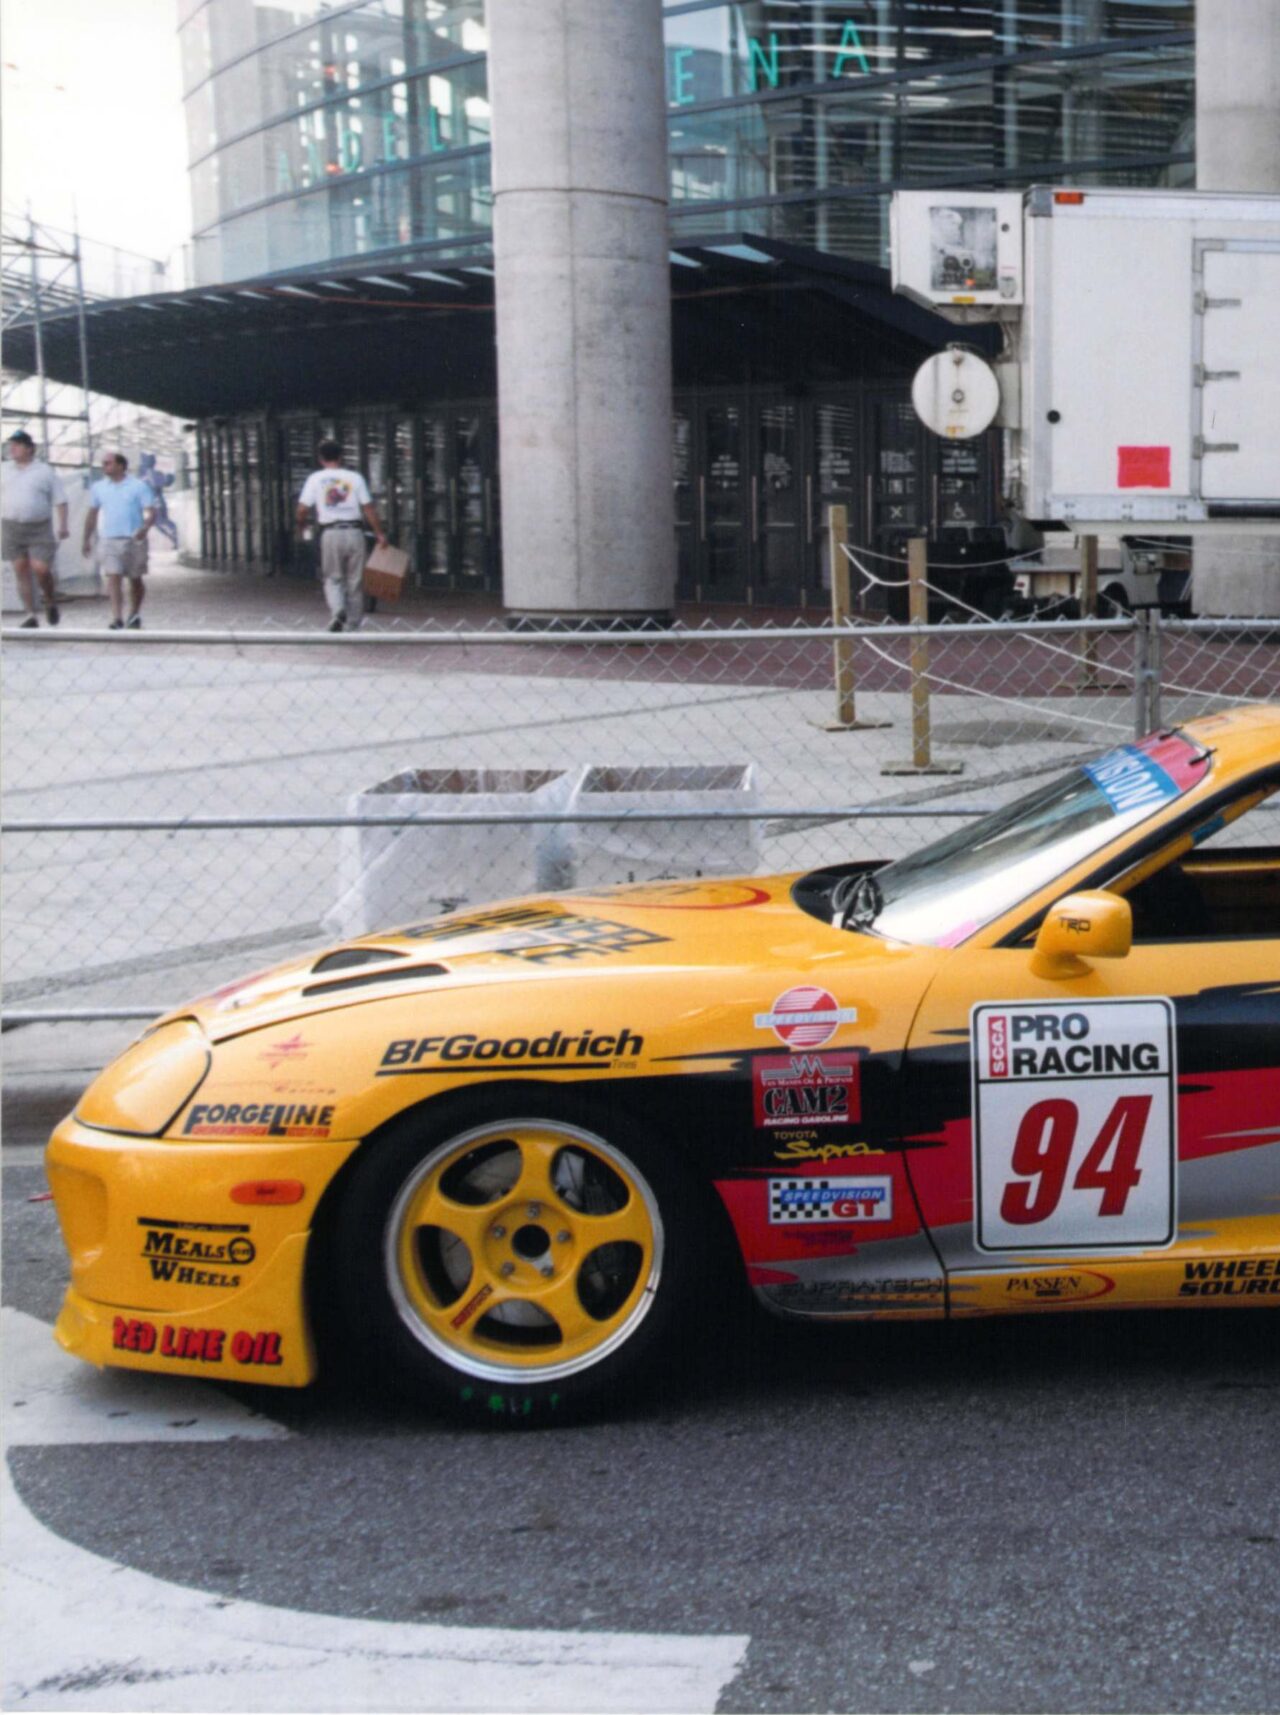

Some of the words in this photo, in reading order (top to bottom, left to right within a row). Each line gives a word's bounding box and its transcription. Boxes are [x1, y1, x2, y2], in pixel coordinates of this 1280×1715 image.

[1058, 916, 1091, 934] TRD
[1011, 1013, 1089, 1042] PRO
[380, 1029, 644, 1066] BFGoodrich
[990, 1019, 1007, 1073] SCCA
[1013, 1044, 1159, 1076] RACING
[763, 1086, 848, 1116] CAM2
[774, 1131, 818, 1140] TOYOTA
[774, 1140, 885, 1164] Supra
[1000, 1094, 1153, 1226] 94
[784, 1188, 883, 1202] SPEEDVISION
[832, 1200, 880, 1218] GT
[1006, 1276, 1081, 1291] PASSEN
[113, 1317, 156, 1353] RED
[160, 1325, 226, 1362] LINE
[231, 1331, 282, 1365] OIL
